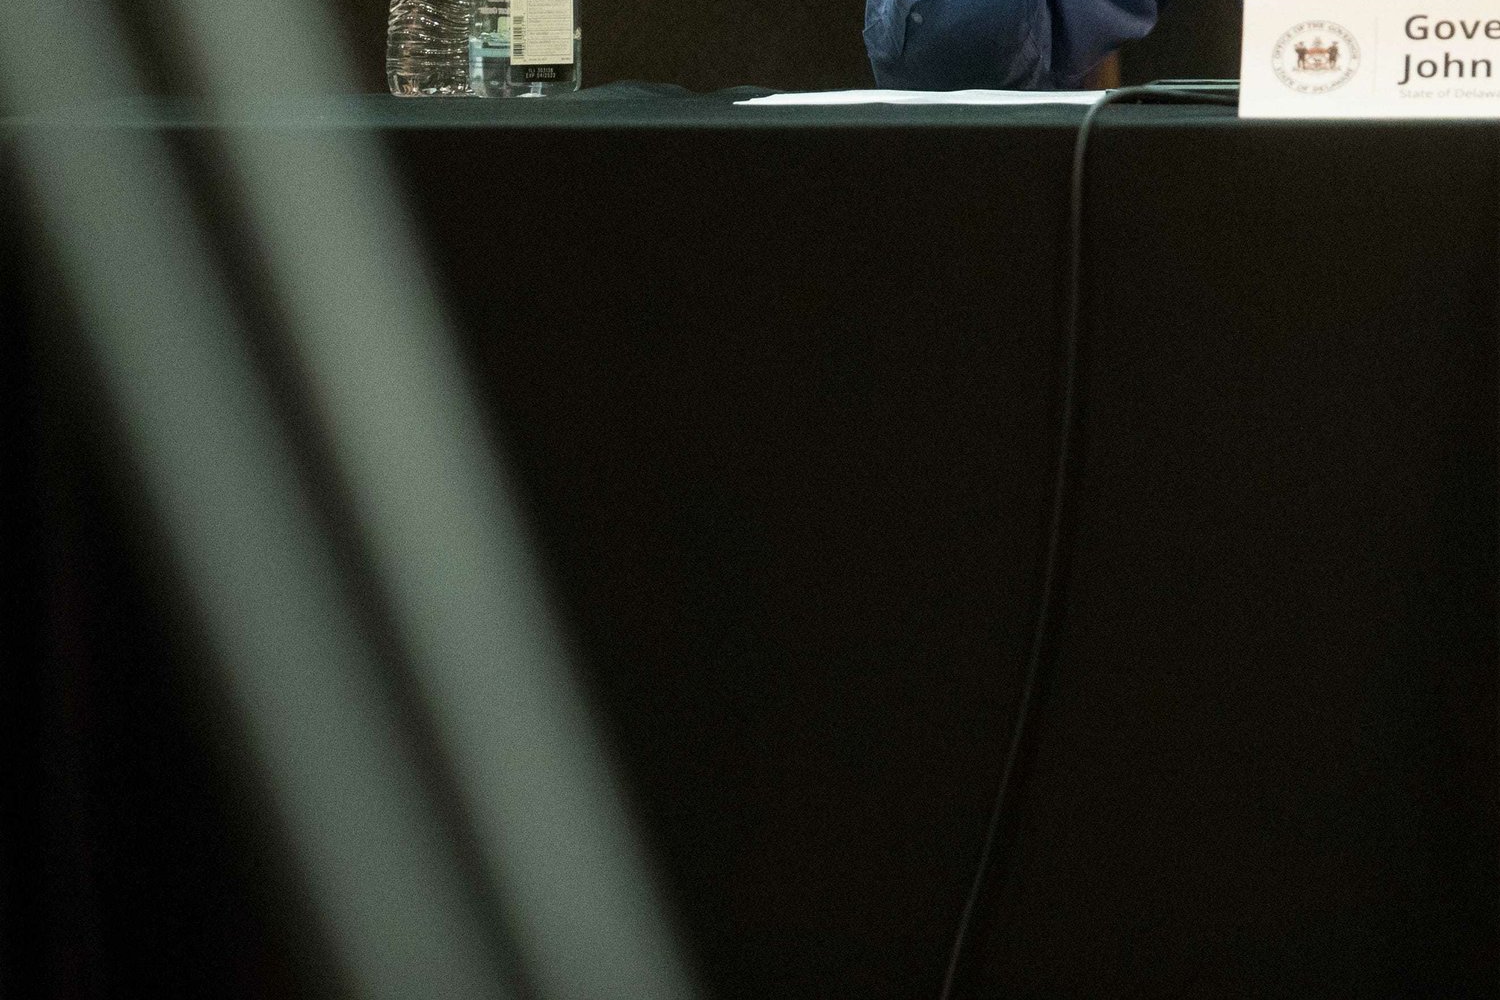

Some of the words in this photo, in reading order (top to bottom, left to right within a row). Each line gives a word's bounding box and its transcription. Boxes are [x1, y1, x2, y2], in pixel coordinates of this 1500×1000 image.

[1397, 52, 1492, 86] John
[1399, 88, 1434, 98] State
[1436, 88, 1452, 98] of
